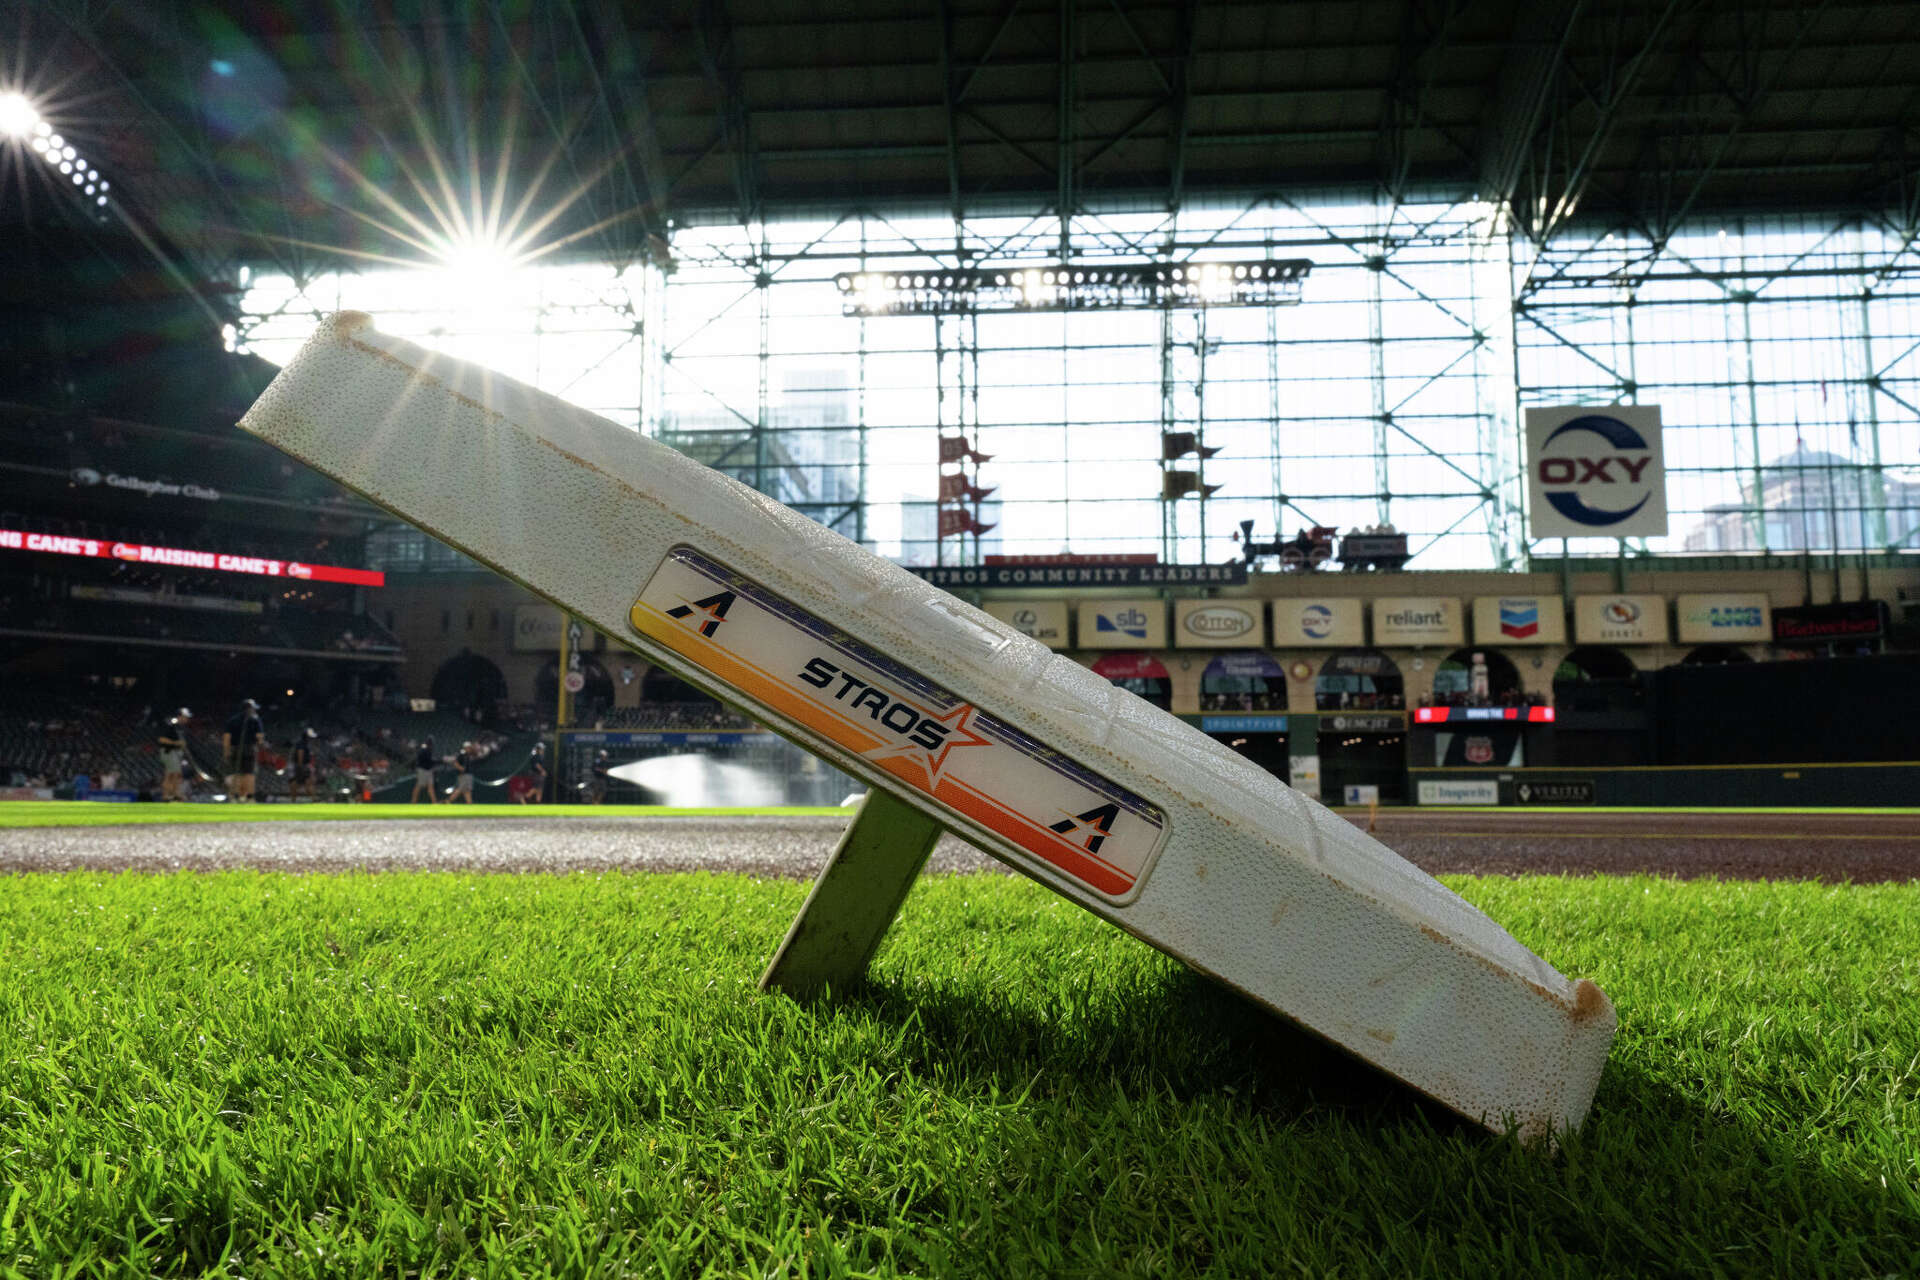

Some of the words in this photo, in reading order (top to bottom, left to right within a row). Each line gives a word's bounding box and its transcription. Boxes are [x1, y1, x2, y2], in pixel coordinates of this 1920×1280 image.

[1539, 456, 1652, 484] OXY
[106, 474, 181, 494] Gallagher
[183, 482, 220, 499] Club
[140, 545, 215, 568] RAISING
[218, 554, 279, 575] CANE'S
[999, 567, 1129, 583] COMMUNITY
[1140, 567, 1234, 582] LEADERS
[1116, 609, 1147, 627] slb
[1302, 617, 1331, 628] OXY
[1386, 609, 1442, 626] reliant
[798, 656, 952, 750] STROS
